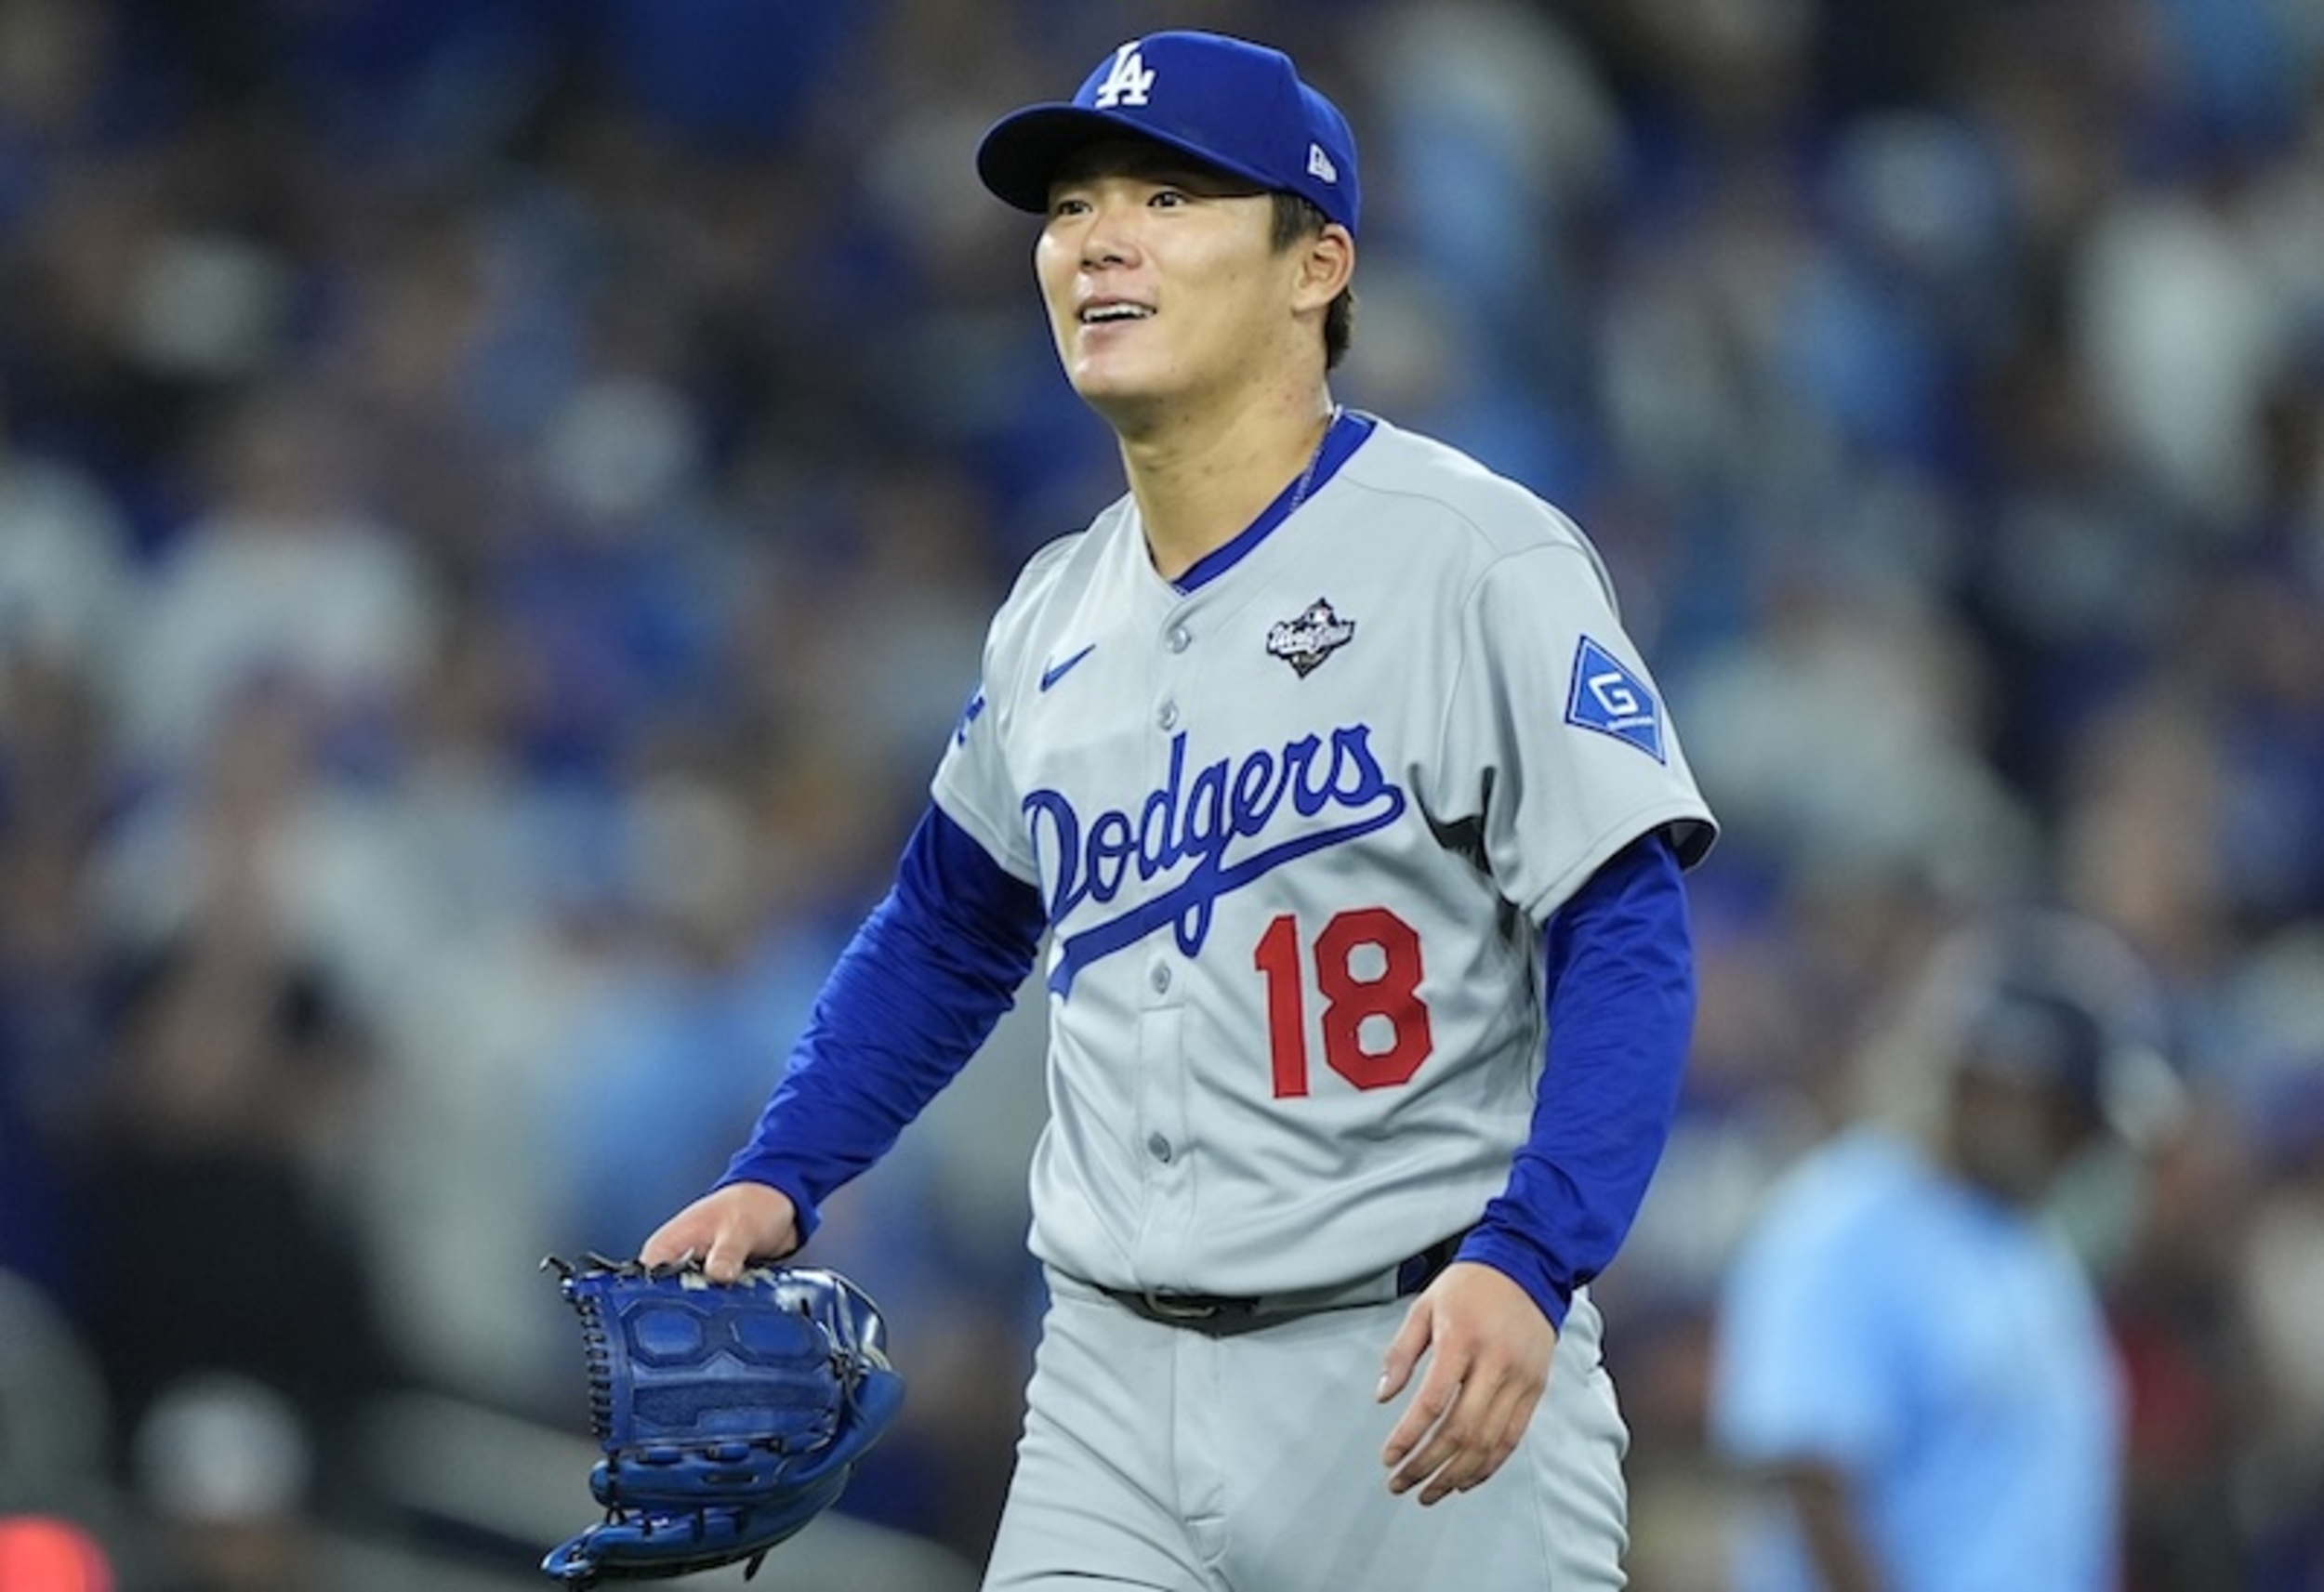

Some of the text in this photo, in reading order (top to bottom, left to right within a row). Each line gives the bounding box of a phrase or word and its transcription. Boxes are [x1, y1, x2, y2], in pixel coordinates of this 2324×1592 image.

[1095, 41, 1155, 108] LA
[1589, 672, 1639, 716] G
[1023, 723, 1406, 999] Dodgers
[1254, 906, 1433, 1099] 18
